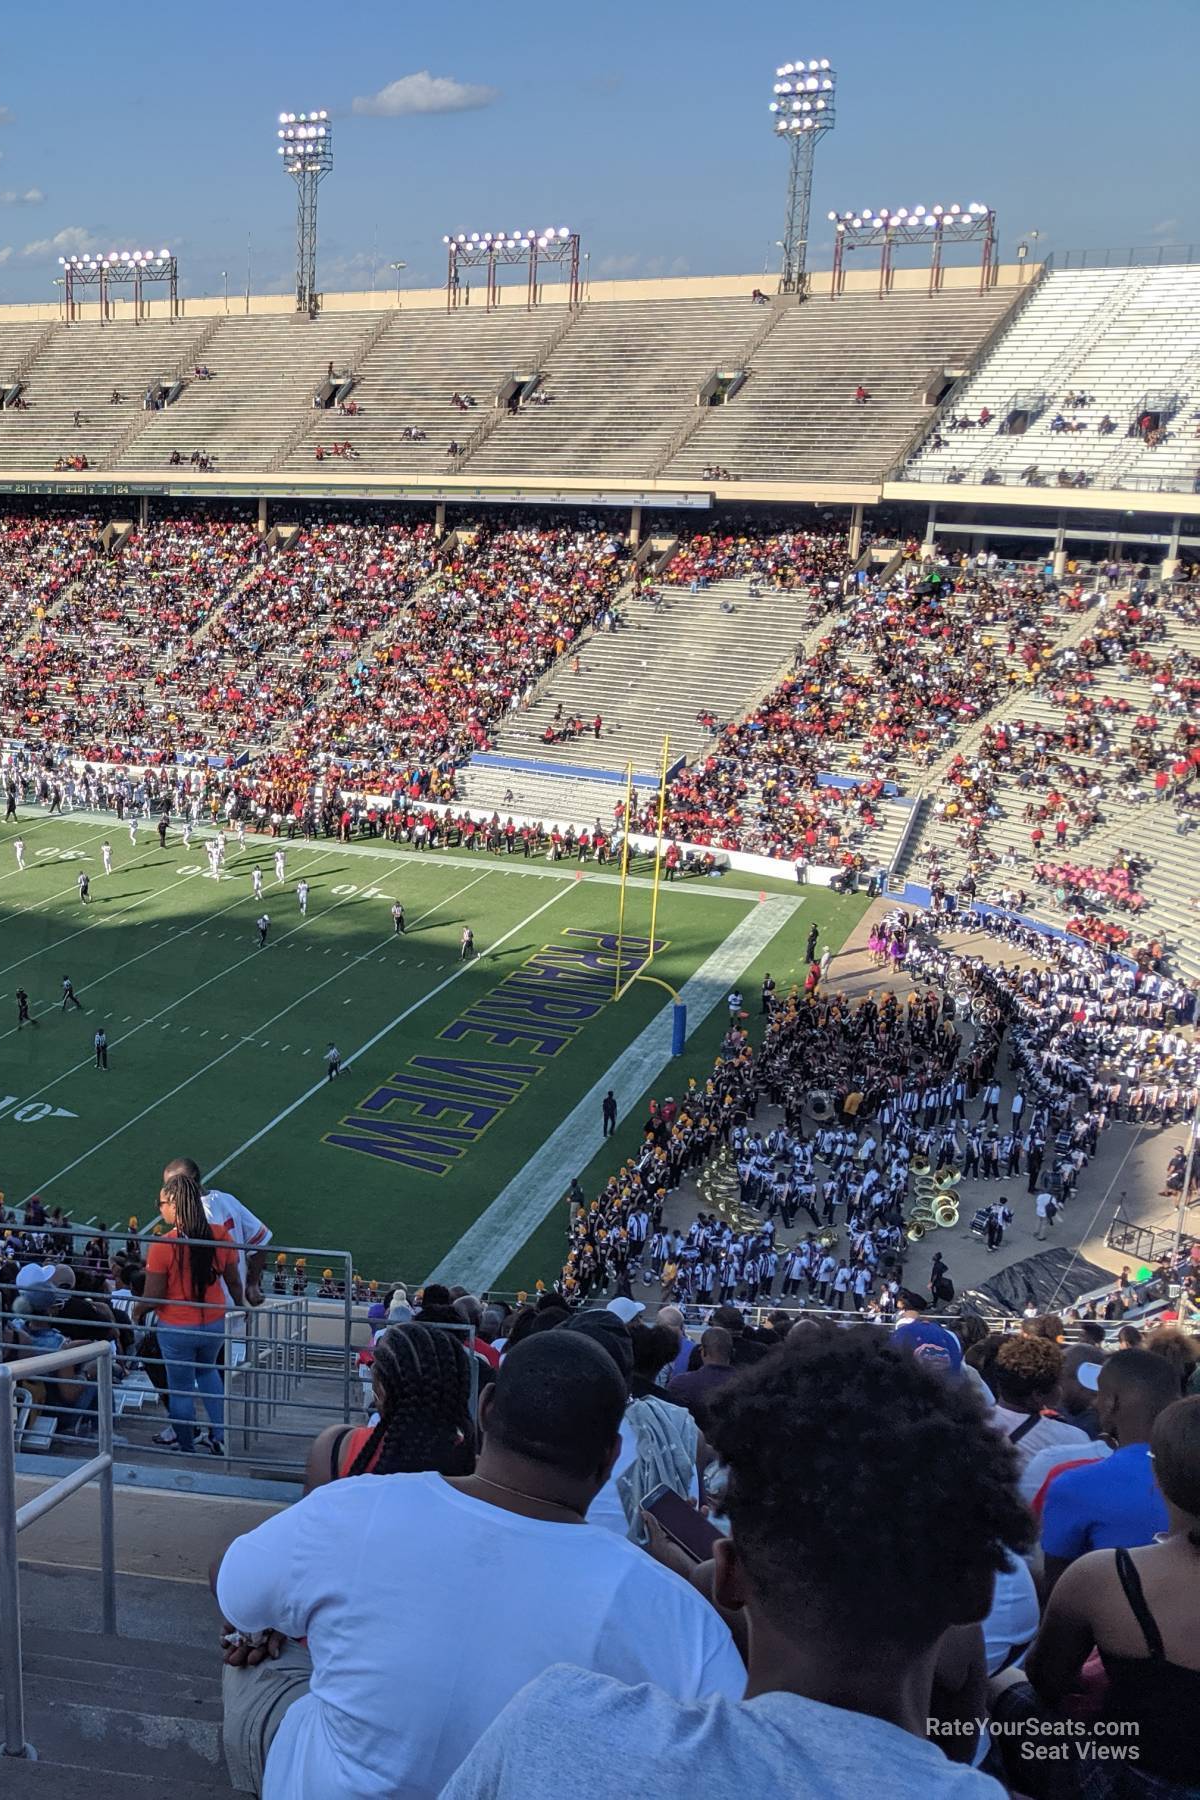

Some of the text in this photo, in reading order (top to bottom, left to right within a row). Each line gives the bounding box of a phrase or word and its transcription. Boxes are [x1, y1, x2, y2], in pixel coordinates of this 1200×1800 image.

[15, 484, 26, 493] 23
[117, 485, 129, 494] 24
[320, 927, 671, 1178] PRAIRIE VIEW
